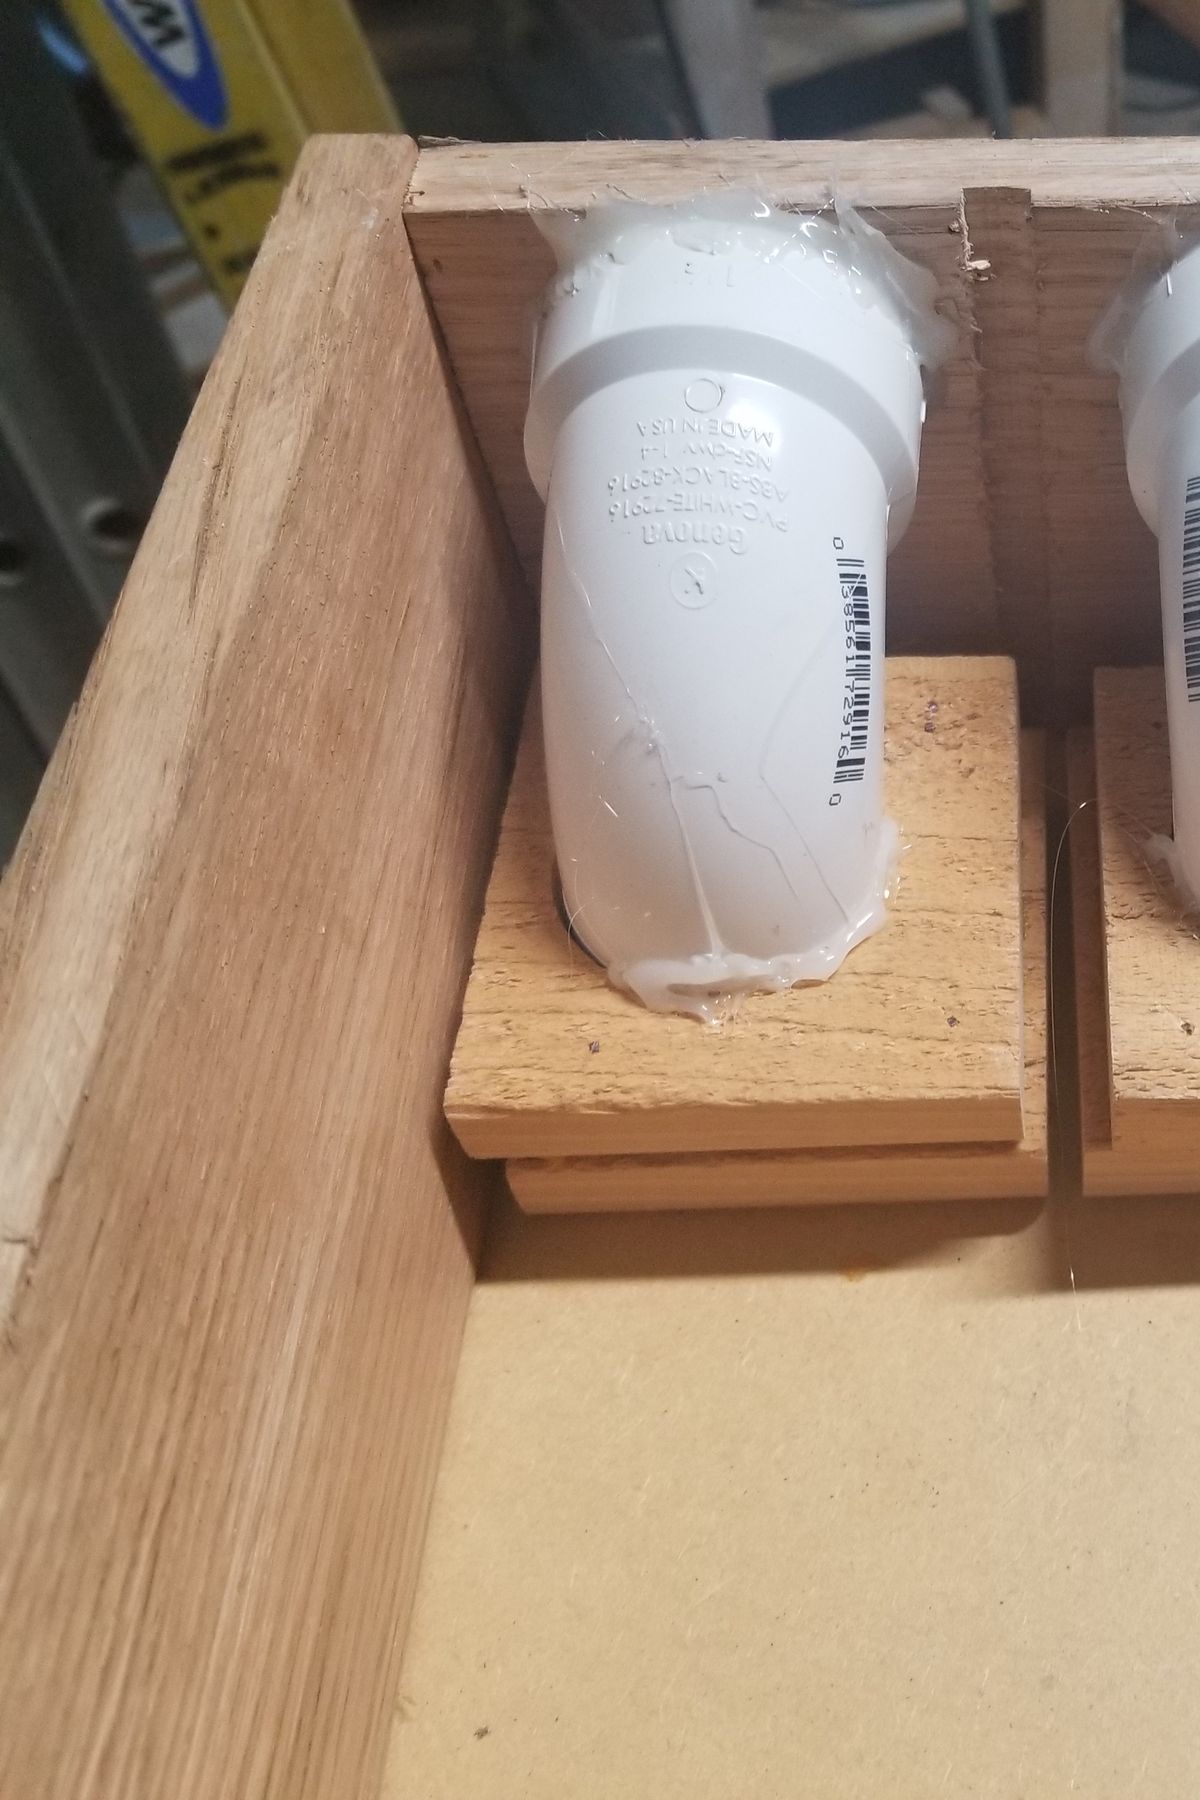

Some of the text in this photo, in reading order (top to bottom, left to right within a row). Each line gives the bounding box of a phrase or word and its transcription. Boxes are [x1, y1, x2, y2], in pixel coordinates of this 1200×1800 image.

[682, 418, 702, 433] IN
[709, 418, 773, 447] MADE
[642, 522, 747, 555] Genova
[837, 680, 855, 759] 72916
